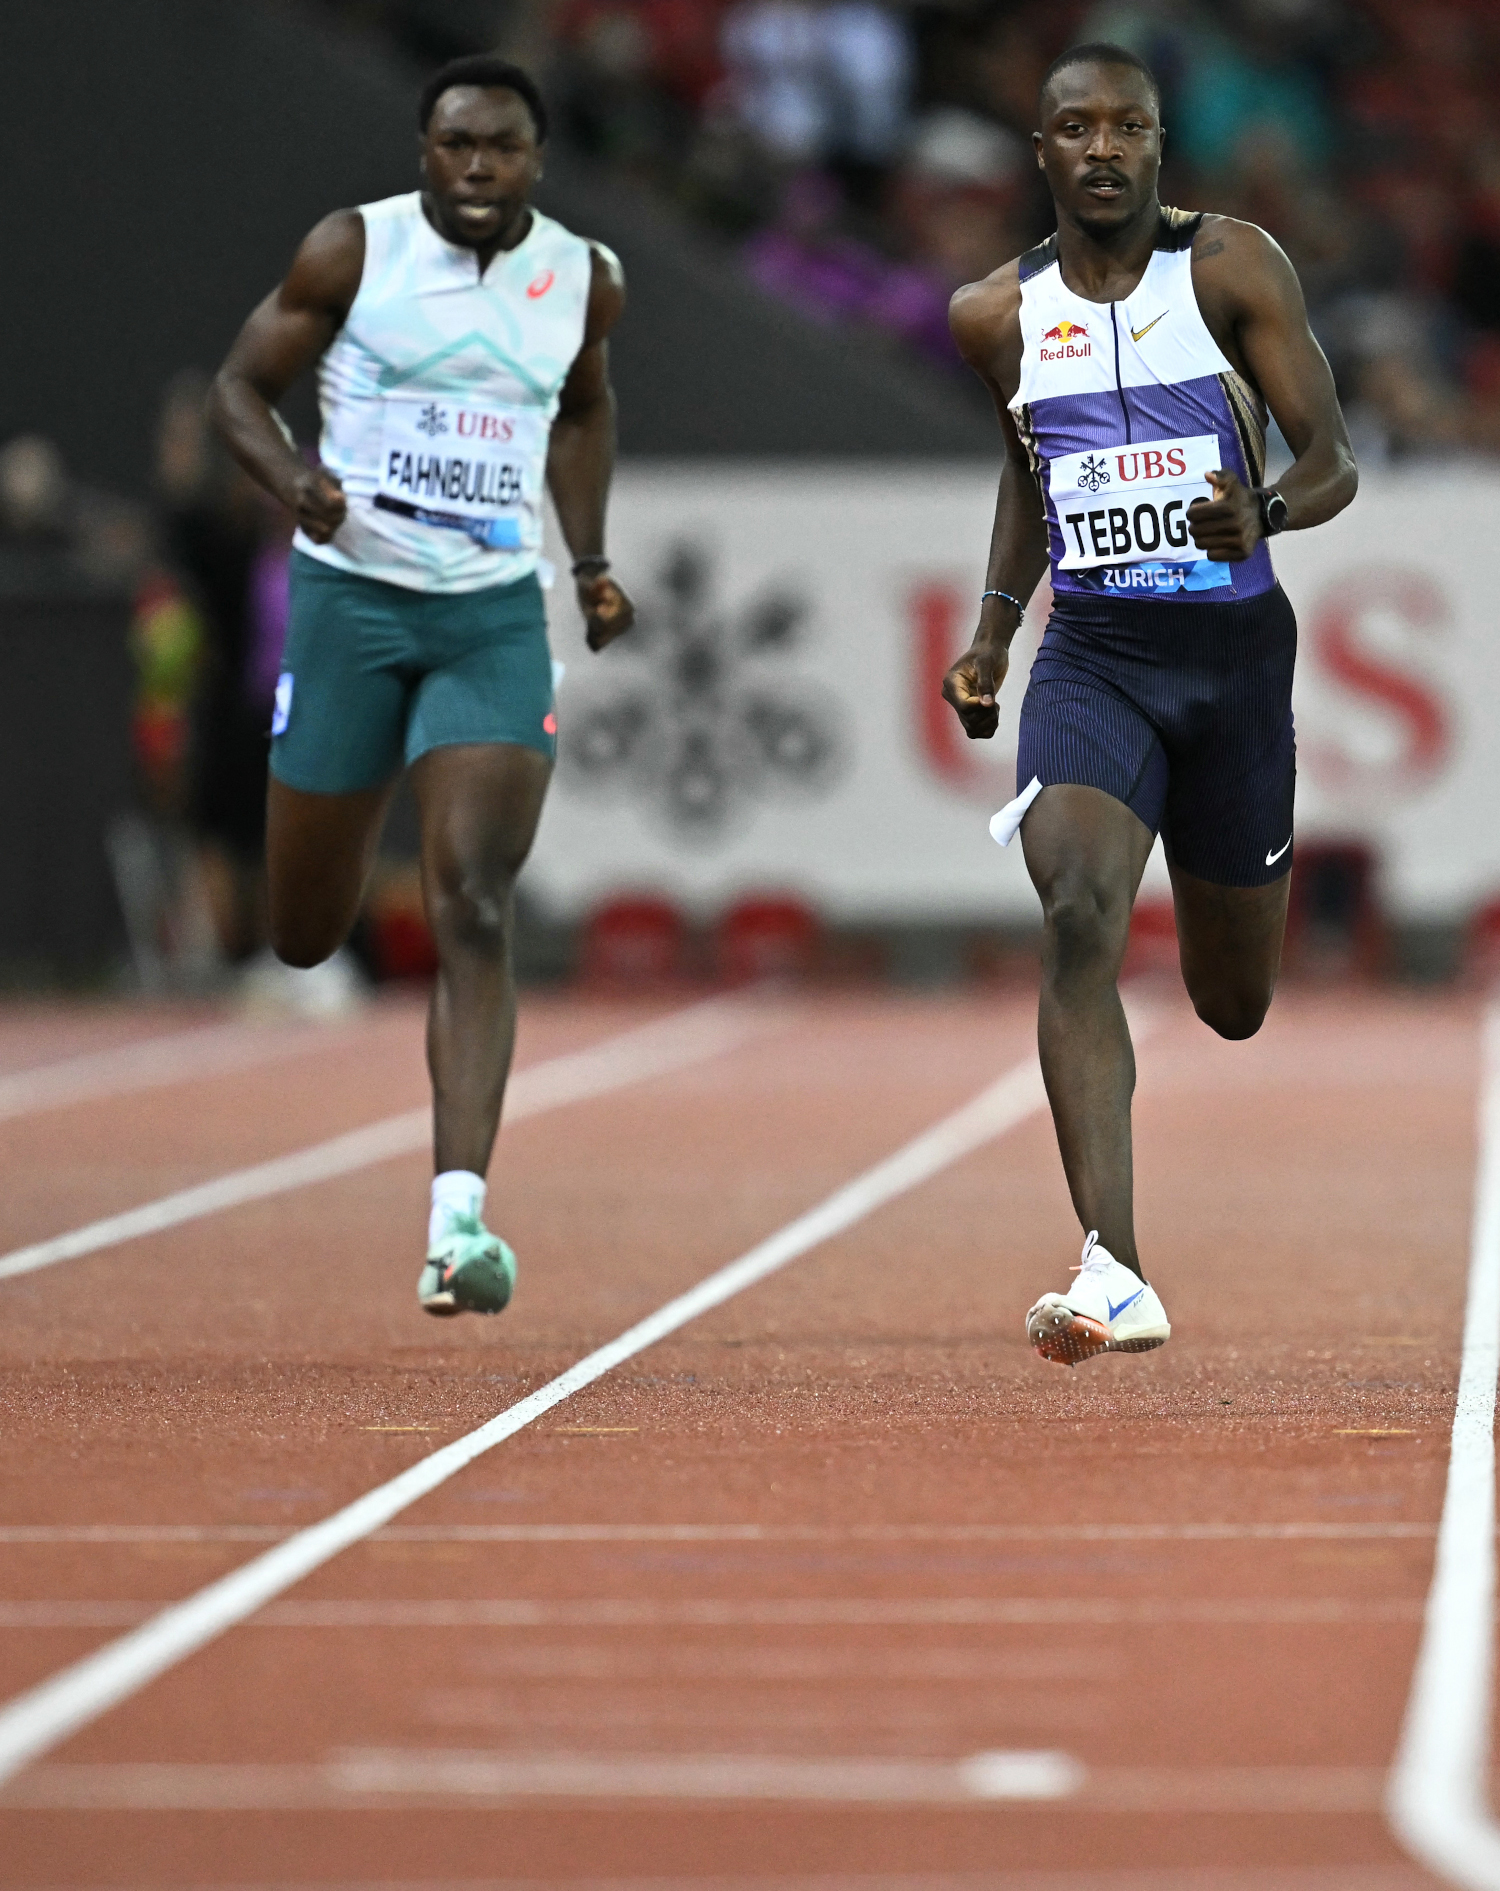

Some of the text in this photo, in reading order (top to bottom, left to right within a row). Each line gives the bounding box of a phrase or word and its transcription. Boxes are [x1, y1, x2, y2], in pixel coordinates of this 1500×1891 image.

[1040, 343, 1091, 361] Red Bull
[457, 411, 515, 442] UBS
[1115, 448, 1187, 482] UBS
[1065, 496, 1214, 558] TEBOG
[1103, 567, 1185, 588] ZURICH
